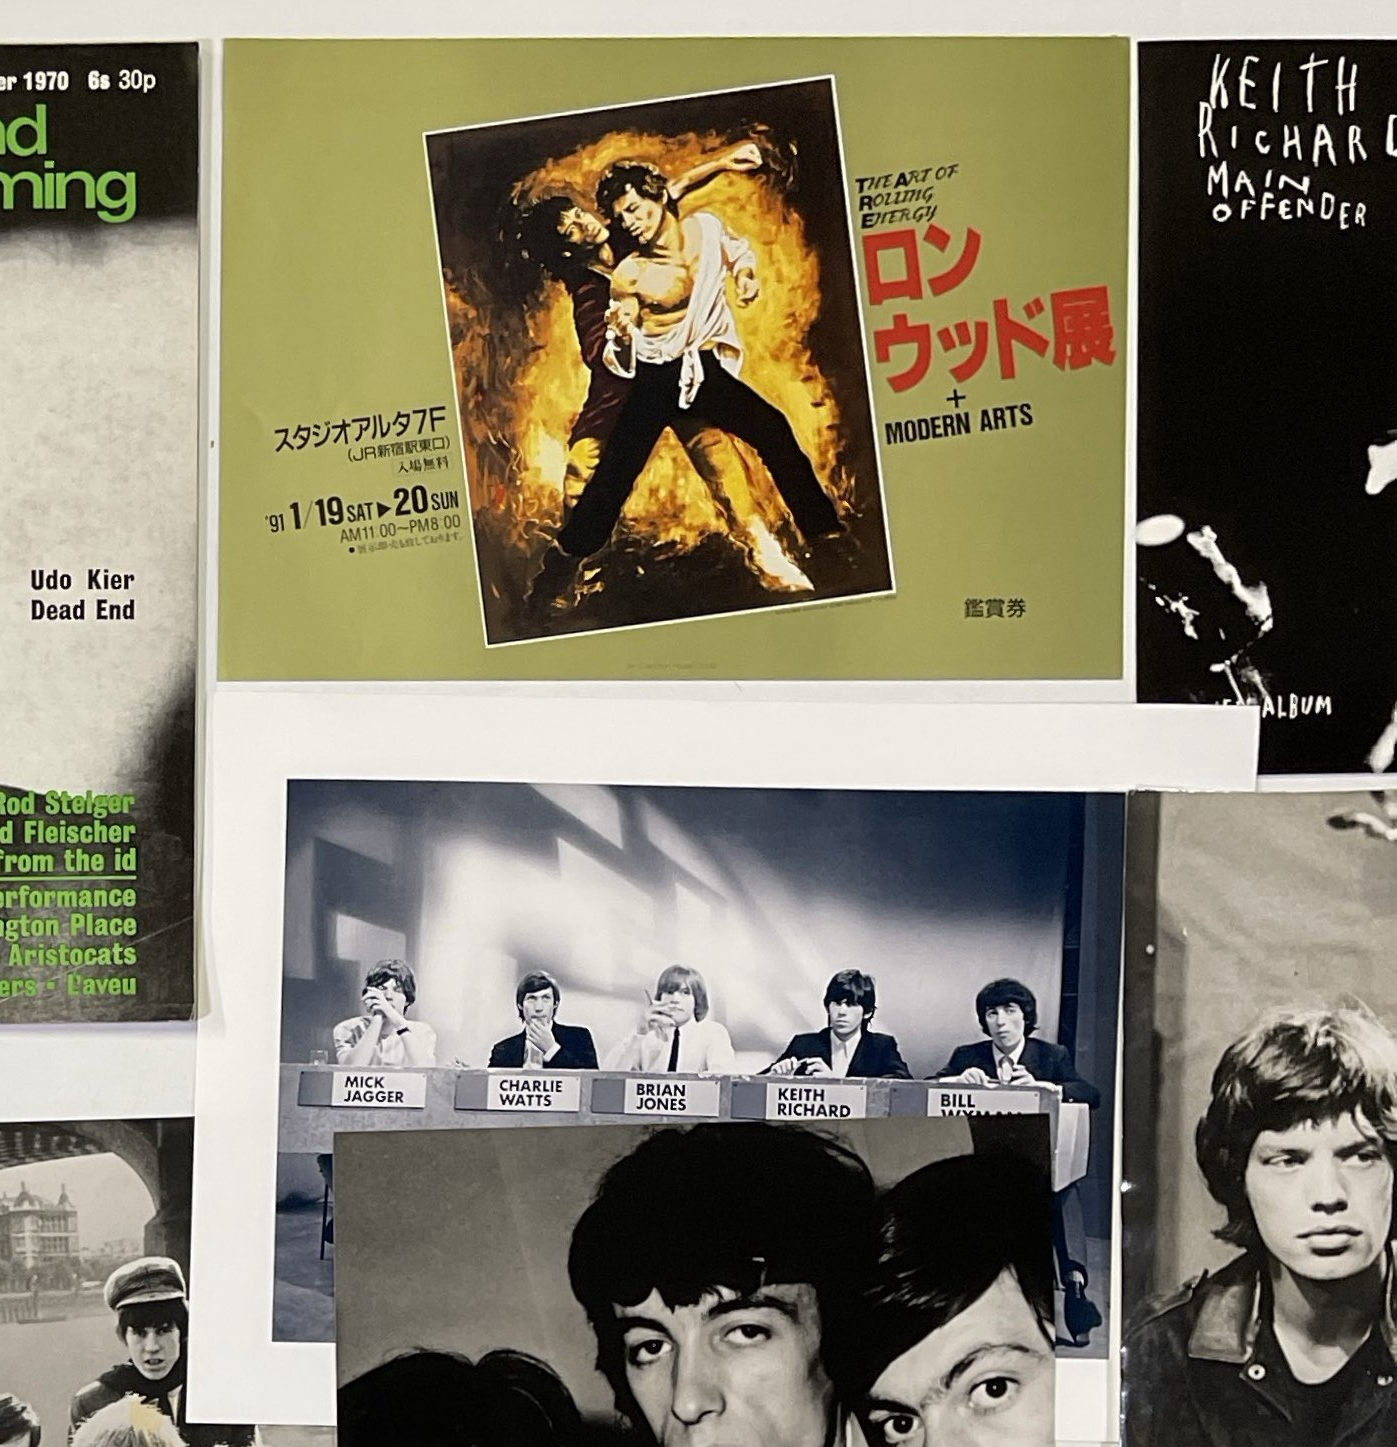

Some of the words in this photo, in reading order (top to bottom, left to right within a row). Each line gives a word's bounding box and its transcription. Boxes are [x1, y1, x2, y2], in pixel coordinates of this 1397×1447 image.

[23, 71, 69, 91] 1970
[87, 70, 111, 90] 6s
[118, 69, 156, 93] 30p
[1209, 52, 1358, 116] KEITH
[935, 163, 960, 181] OF
[1207, 160, 1310, 200] MAIN
[1212, 191, 1367, 230] OFFENDER
[862, 223, 982, 306] ロン
[873, 286, 1117, 394] ウッド展
[274, 405, 447, 453] スタジオアルタ7F
[885, 412, 972, 446] MODERN
[980, 403, 1035, 433] ARTS
[289, 496, 345, 530] 1/19
[346, 502, 375, 523] SAT
[393, 485, 429, 517] 20
[430, 490, 460, 511] SUN
[31, 569, 72, 590] Udo
[88, 569, 135, 590] Kier
[31, 599, 85, 620] Dead
[96, 599, 135, 620] End
[1262, 693, 1332, 719] ALBUM
[45, 790, 135, 818] Steiger
[24, 819, 136, 843] Fleischer
[64, 848, 105, 872] the
[114, 847, 136, 871] id
[70, 913, 137, 936] Place
[8, 943, 137, 966] Aristocats
[344, 1077, 384, 1090] MICK
[499, 1080, 563, 1093] CHARLIE
[636, 1084, 686, 1097] BRIAN
[777, 1088, 825, 1102] KEITH
[343, 1090, 404, 1104] JAGGER
[499, 1094, 552, 1107] WATTS
[636, 1097, 686, 1111] JONES
[940, 1094, 975, 1108] BILL
[777, 1102, 851, 1118] RICHARD
